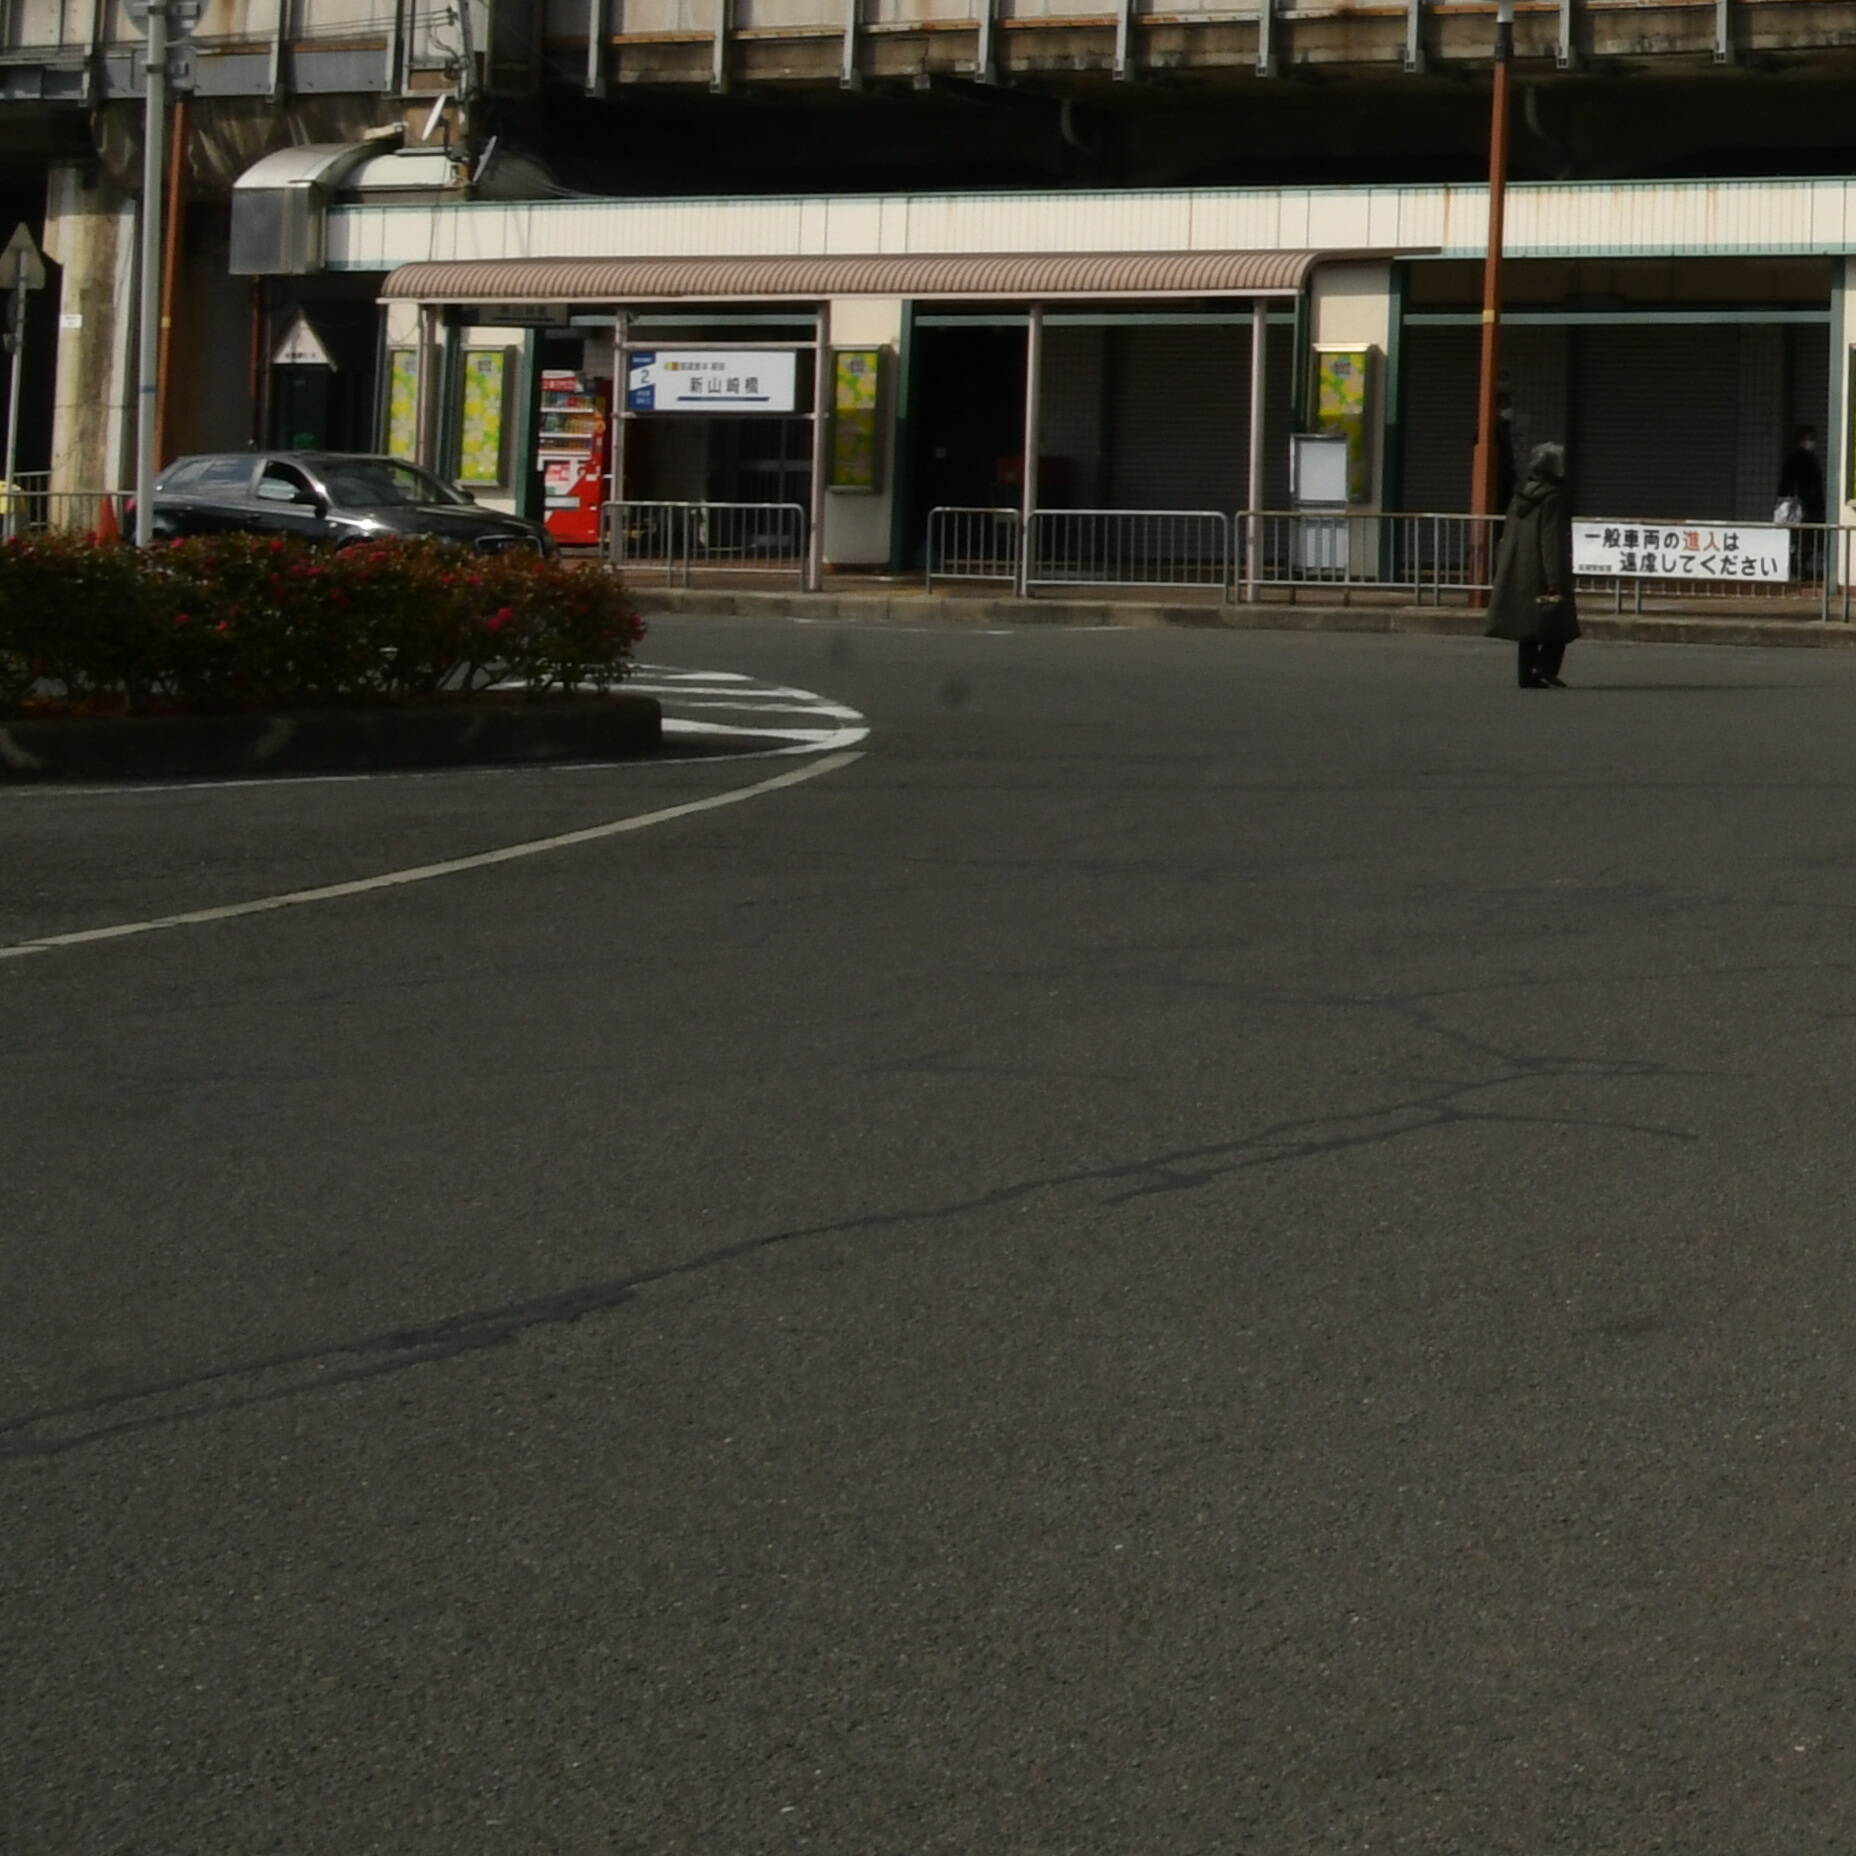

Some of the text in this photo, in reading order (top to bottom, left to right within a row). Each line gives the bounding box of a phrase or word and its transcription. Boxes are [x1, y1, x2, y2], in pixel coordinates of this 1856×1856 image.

[640, 369, 650, 384] 2
[1584, 528, 1740, 552] 一般車両の進入は
[1619, 551, 1778, 577] 遠慮してください
